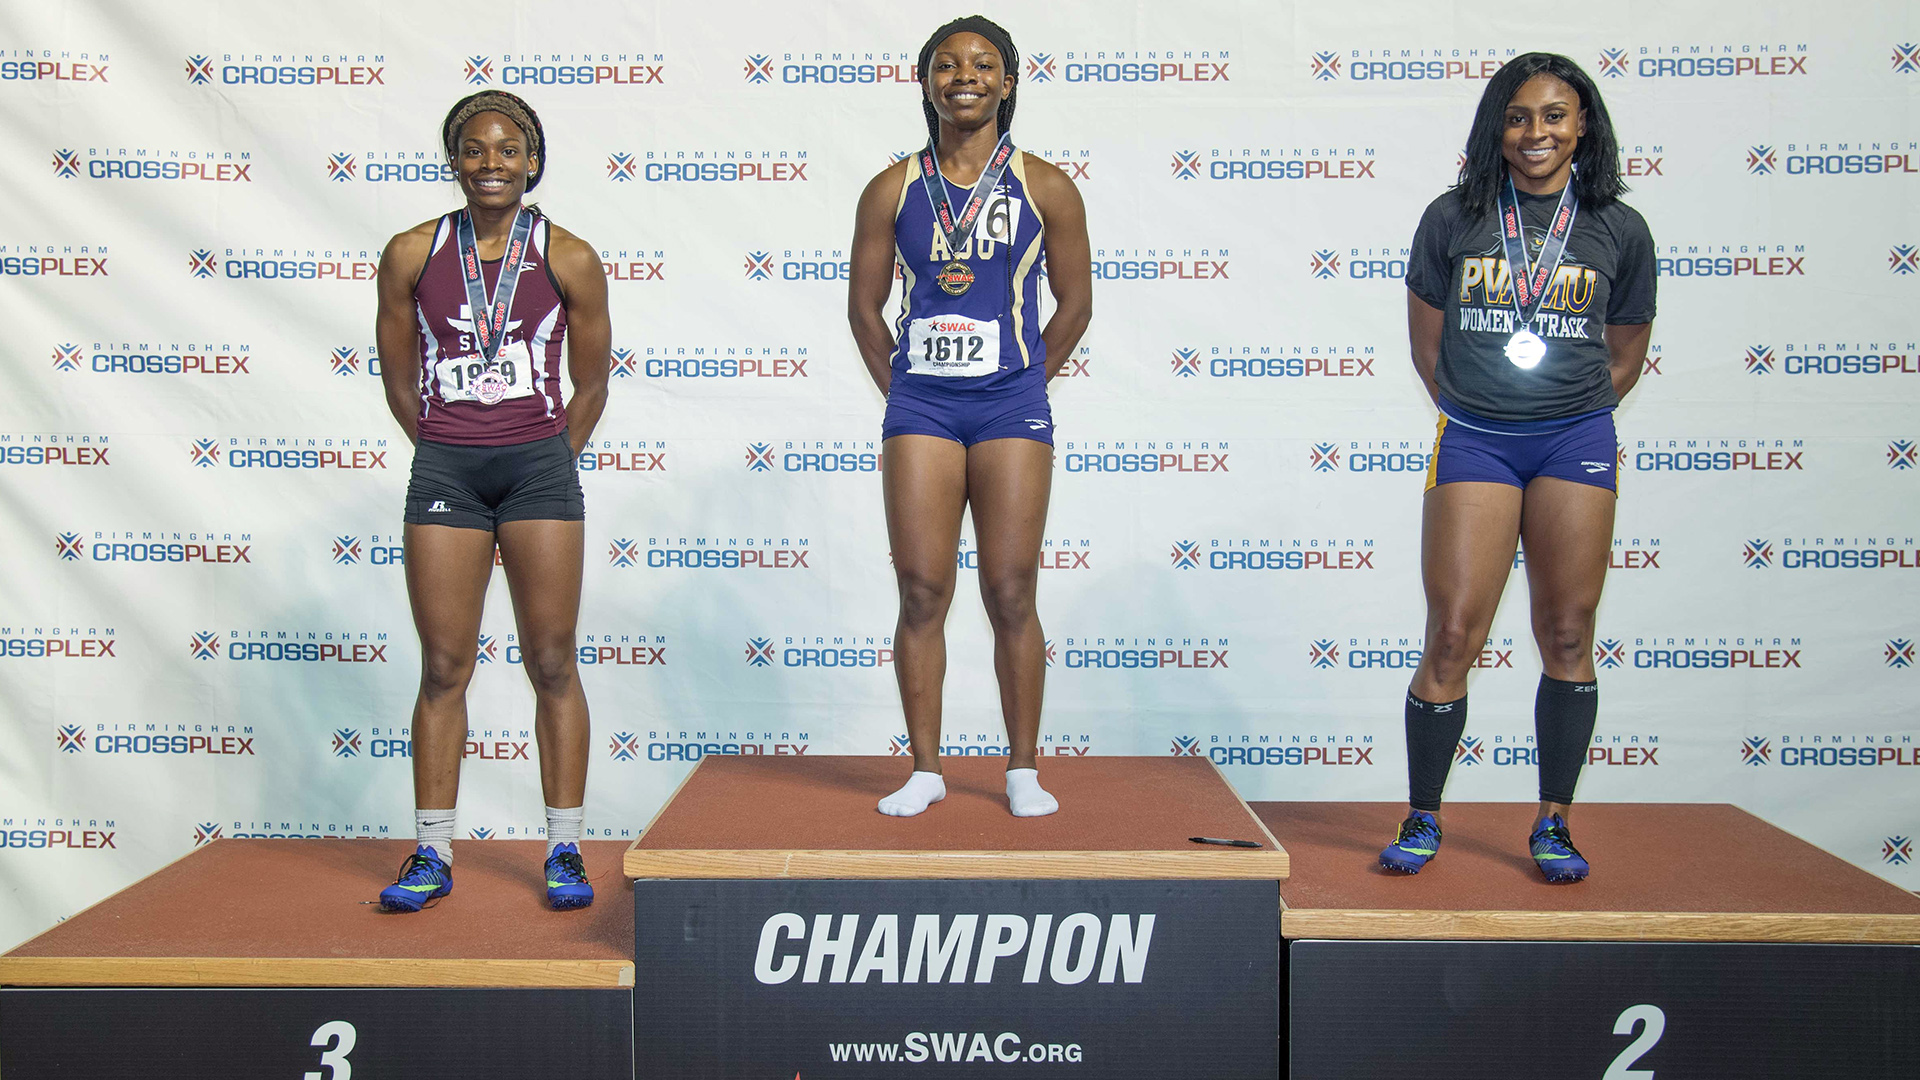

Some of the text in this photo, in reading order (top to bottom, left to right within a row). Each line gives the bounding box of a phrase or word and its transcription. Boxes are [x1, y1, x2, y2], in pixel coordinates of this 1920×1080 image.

[224, 54, 384, 63] BIRMINGHAM
[504, 54, 664, 62] BIRMINGHAM
[784, 53, 908, 62] BIRMINGH
[1067, 51, 1229, 60] BIRMINGHAM
[1352, 49, 1516, 58] BIRMINGHAM
[1640, 44, 1807, 54] BIRMINGHAM
[222, 66, 385, 86] CROSSPLEX
[502, 65, 664, 85] CROSSPLEX
[1065, 62, 1230, 82] CROSSPLEX
[1351, 61, 1505, 81] CROSSPLE
[1639, 56, 1807, 77] CROSSPLEX
[89, 148, 251, 160] BIRMINGHAM
[647, 151, 807, 159] BIRMINGHAM
[1212, 148, 1375, 157] BIRMINGHAM
[89, 160, 252, 183] CROSSPLEX
[366, 163, 457, 183] CROSS
[645, 163, 808, 182] CROSSPLEX
[923, 155, 935, 177] SWAC
[1210, 161, 1375, 180] CROSSPLEX
[965, 197, 982, 221] SWAC
[986, 198, 1011, 239] 6
[940, 210, 954, 233] SWAC
[1506, 213, 1518, 238] SWAC
[509, 240, 521, 266] SWAC
[1098, 249, 1229, 258] RMINGHAM
[1657, 245, 1805, 255] IRMINGHAM
[466, 254, 478, 280] SWAC
[1091, 261, 1230, 280] ROSSPLEX
[1656, 256, 1806, 278] ROSSPLEX
[947, 274, 974, 283] SWAC
[1532, 268, 1548, 296] SWAC
[1517, 278, 1529, 307] SWAC
[494, 302, 505, 331] SWAC
[1535, 313, 1589, 339] TRACK
[478, 320, 490, 348] SWAC
[939, 322, 976, 332] SWAC
[94, 343, 250, 352] BIRMINGHAM
[647, 347, 807, 355] BIRMINGHAM
[923, 335, 984, 362] 1612
[1212, 347, 1374, 355] BIRMINGHAM
[92, 354, 250, 374] CROSSPLEX
[645, 359, 808, 377] CROSSPLEX
[1210, 358, 1375, 377] CROSSPLEX
[1785, 355, 1920, 374] CROSSPL
[230, 438, 387, 448] BIRMINGHAM
[1067, 442, 1229, 450] BIRMINGHAM
[1638, 440, 1804, 449] BIRMINGHAM
[229, 450, 388, 469] CROSSPLEX
[1066, 454, 1229, 472] CROSSPLEX
[1636, 452, 1804, 471] CROSSPLEX
[95, 532, 252, 541] BIRMINGHAM
[649, 538, 809, 547] BIRMINGHAM
[1211, 539, 1374, 547] BIRMINGHAM
[93, 543, 252, 563] CROSSPLEX
[647, 549, 809, 569] CROSSPLEX
[1210, 551, 1374, 570] CROSSPLEX
[231, 631, 388, 640] BIRMINGHAM
[785, 637, 891, 646] BIRMING
[1067, 639, 1229, 647] BIRMINGHAM
[1636, 638, 1801, 646] BIRMINGHAM
[229, 642, 388, 662] CROSSPLEX
[784, 648, 894, 667] CROSSP
[1065, 650, 1229, 669] CROSSPLEX
[1634, 650, 1802, 668] CROSSPLEX
[97, 724, 254, 734] BIRMINGHAM
[649, 731, 809, 741] BIRMINGHAM
[95, 735, 256, 755] CROSSPLEX
[1211, 735, 1373, 743] BIRMINGHAM
[1210, 747, 1373, 766] CROSSPLEX
[234, 822, 388, 833] BIRMINGHAM
[753, 912, 1156, 985] CHAMPION
[302, 1021, 357, 1080] 3
[1602, 1004, 1666, 1080] 2
